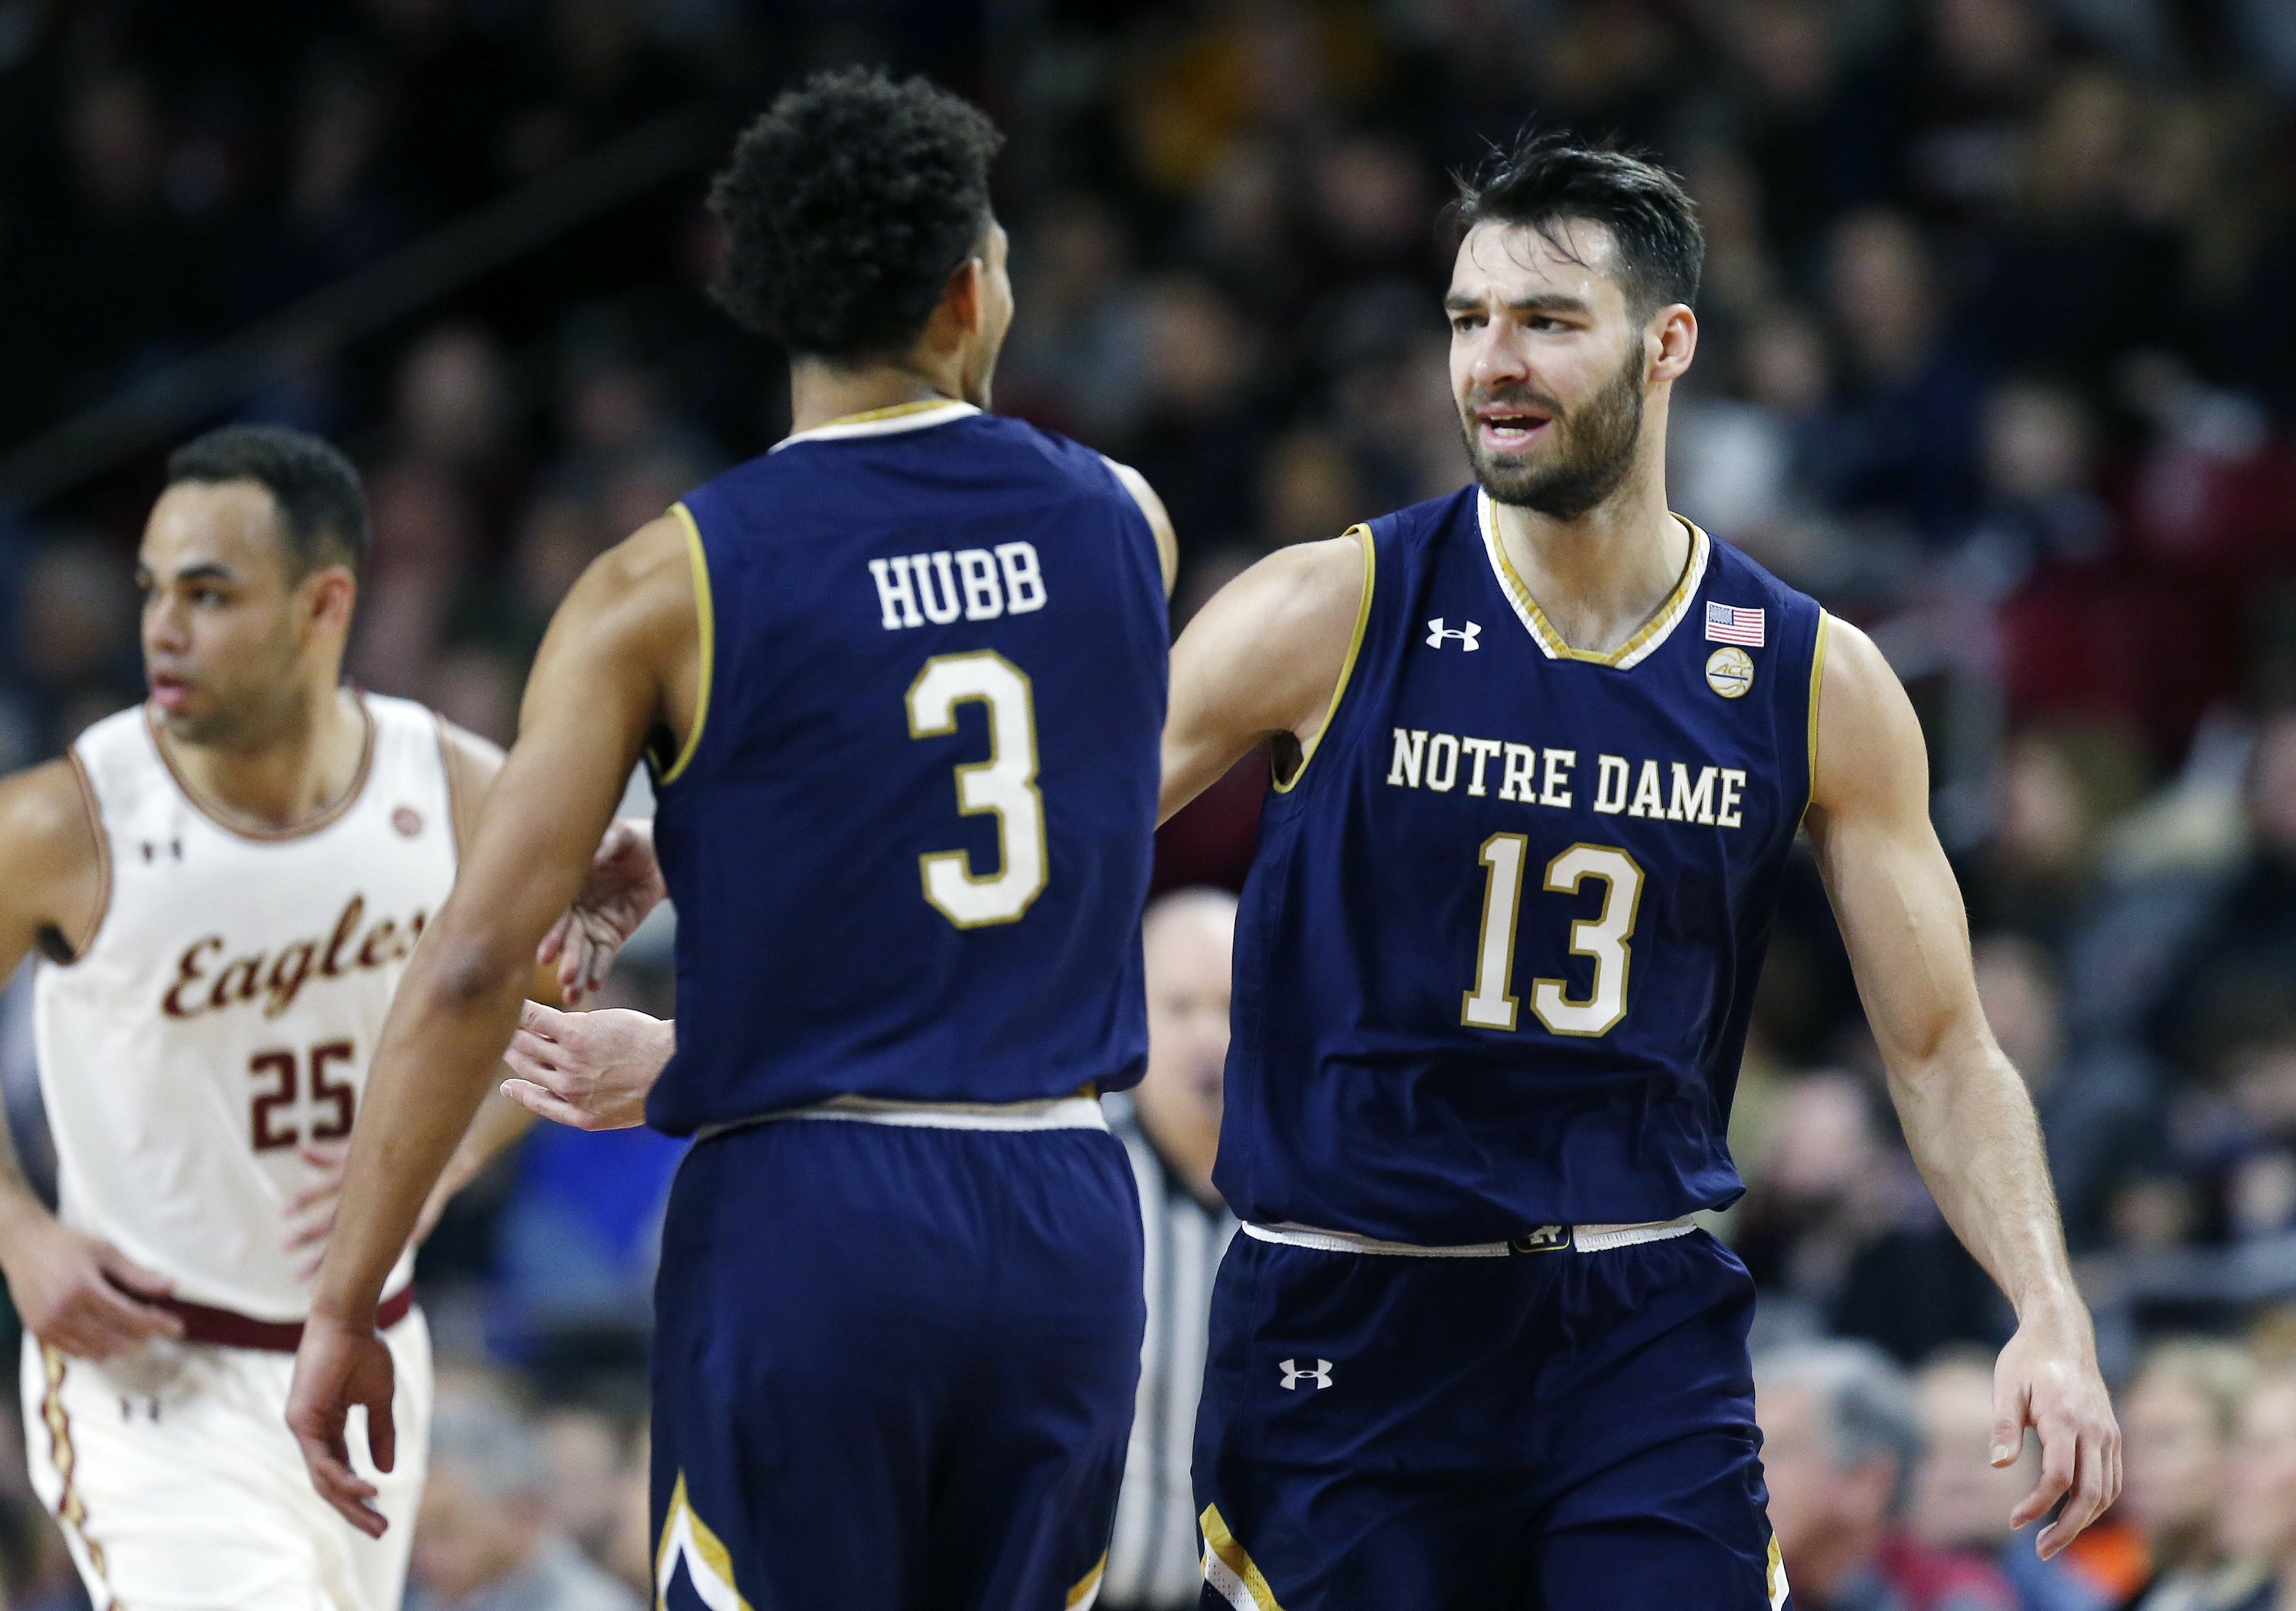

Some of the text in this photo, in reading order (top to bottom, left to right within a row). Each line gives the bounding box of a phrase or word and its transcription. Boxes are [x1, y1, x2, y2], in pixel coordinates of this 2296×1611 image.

[868, 540, 1048, 630] HUBB
[905, 648, 1050, 930] 3
[1386, 728, 1747, 828] NOTRE DAME
[1460, 830, 1645, 1038] 13
[249, 1040, 356, 1156] 25
